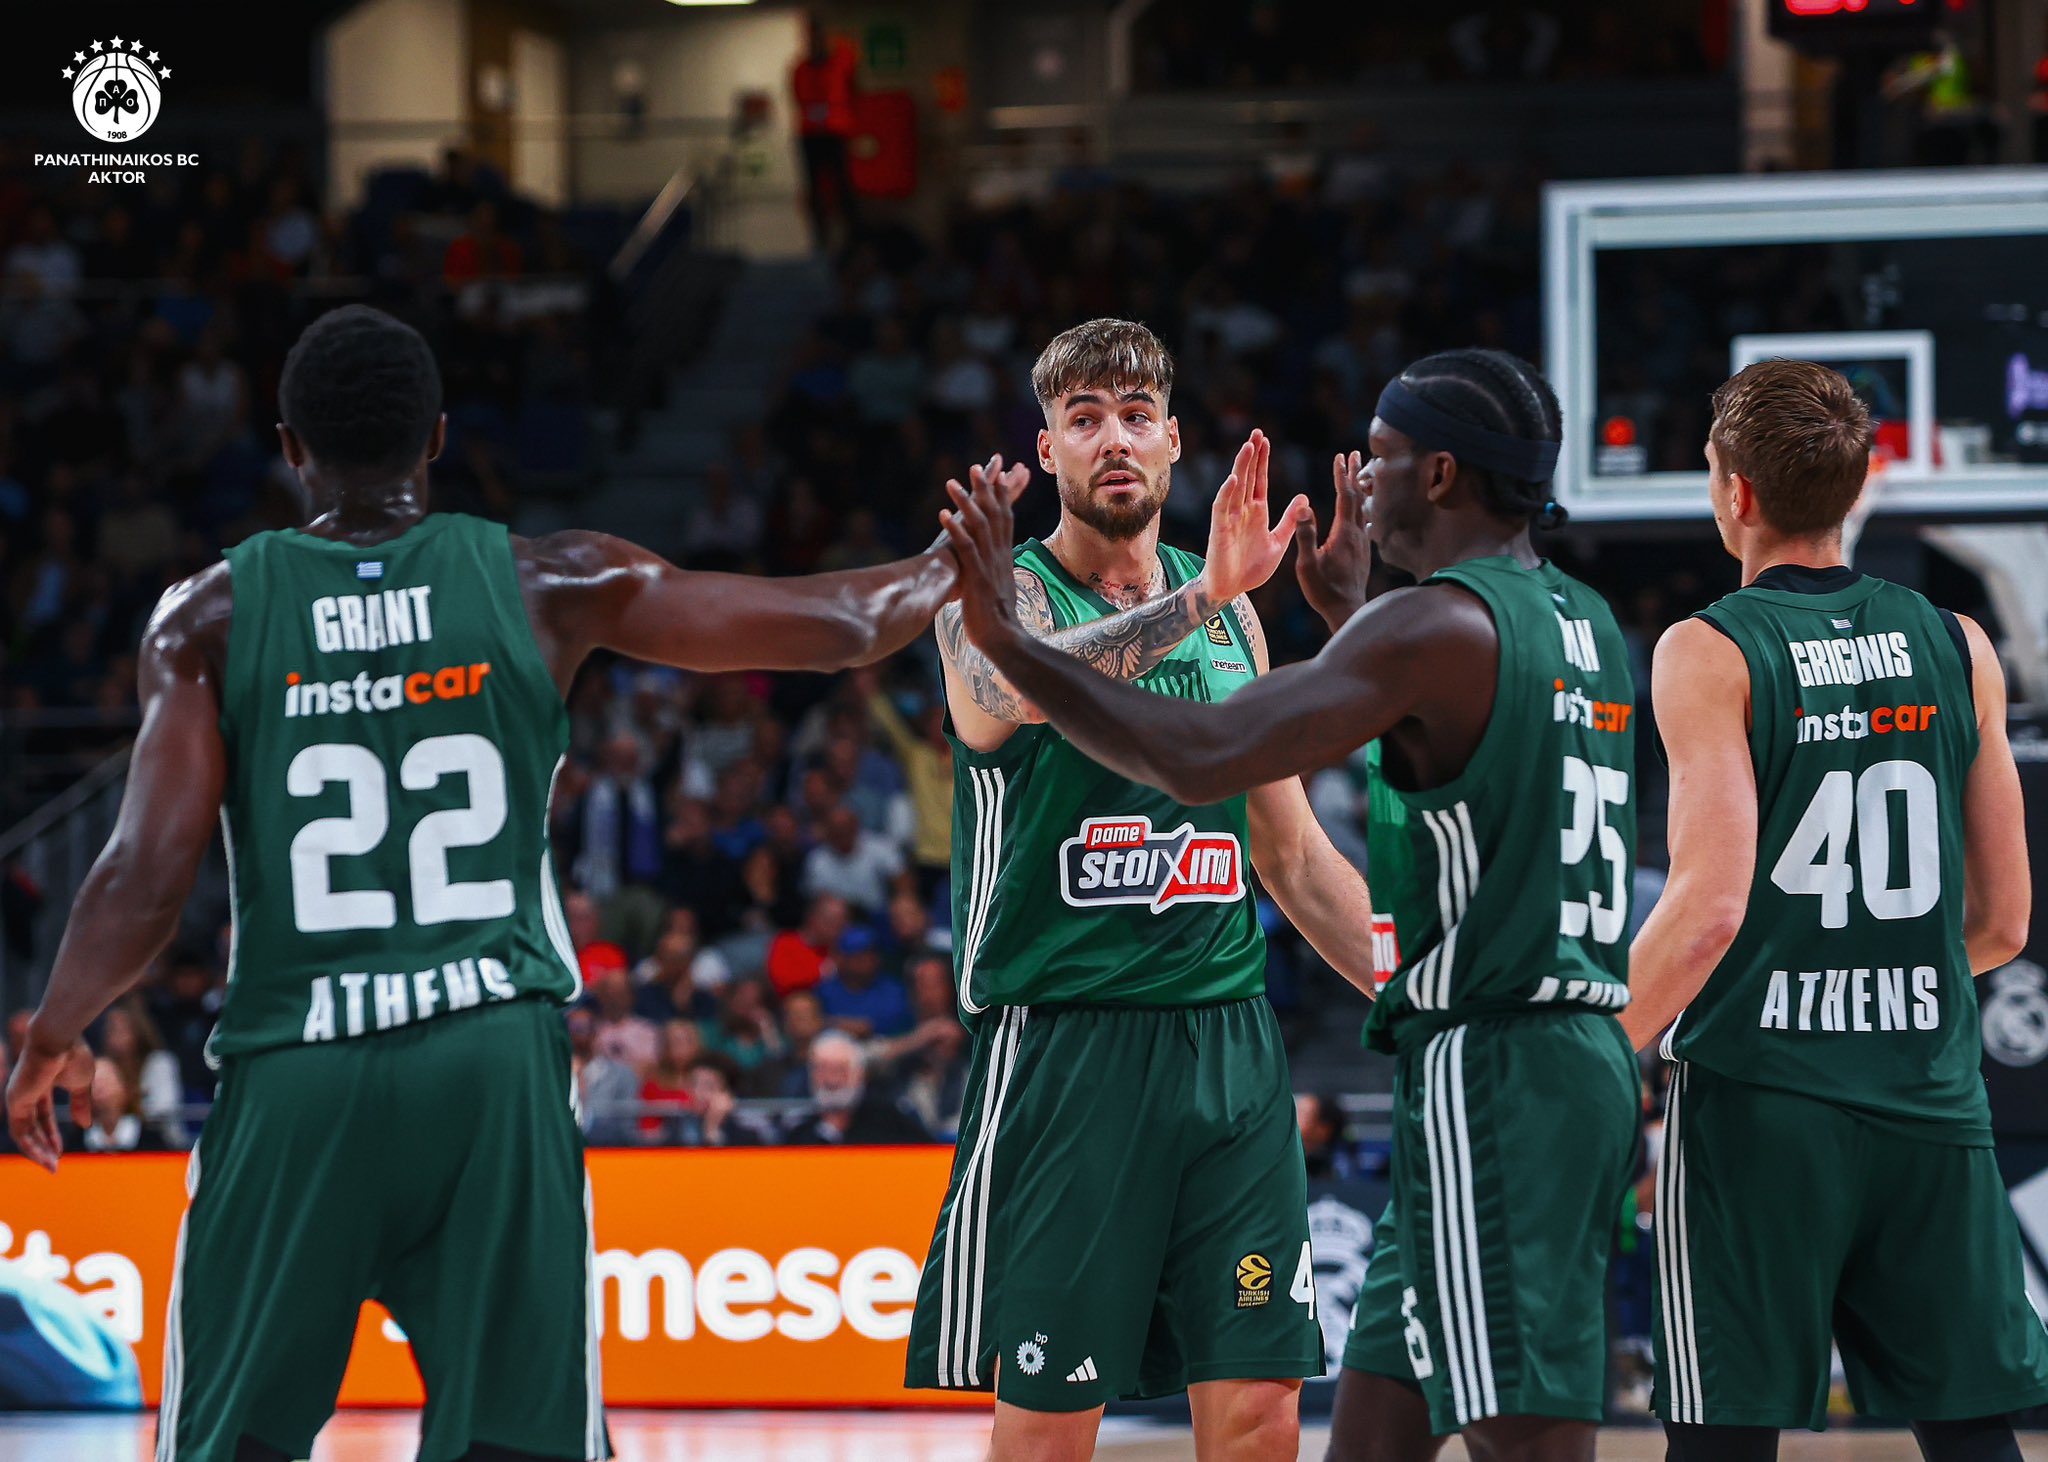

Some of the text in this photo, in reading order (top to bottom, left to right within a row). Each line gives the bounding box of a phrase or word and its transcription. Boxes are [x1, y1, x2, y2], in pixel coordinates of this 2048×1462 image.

[312, 585, 433, 653] GRANT
[285, 662, 491, 718] instacar
[1795, 704, 1937, 744] instacar
[287, 733, 515, 933] 22
[1091, 825, 1140, 847] pame
[1770, 760, 1941, 929] 40
[1759, 966, 1940, 1032] ATHENS
[1035, 1331, 1048, 1345] bp
